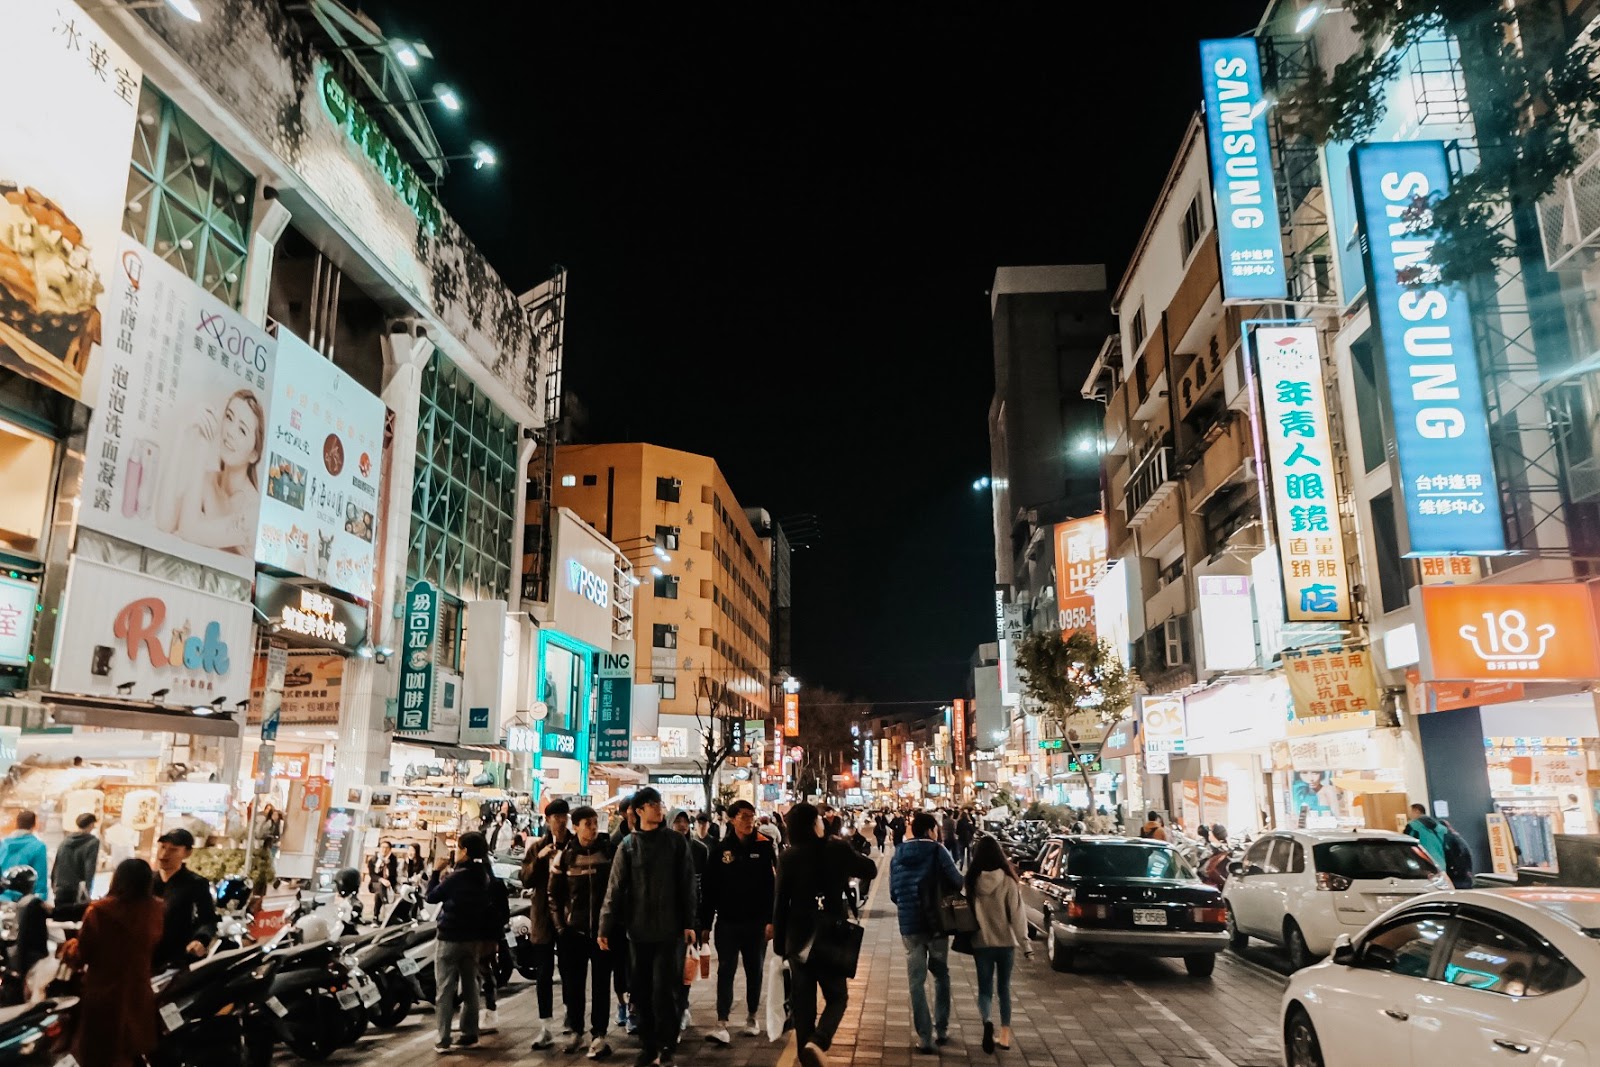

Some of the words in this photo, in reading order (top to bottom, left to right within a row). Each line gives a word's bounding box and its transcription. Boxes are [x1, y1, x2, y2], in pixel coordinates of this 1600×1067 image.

[1214, 57, 1265, 229] SAMSUNG
[1230, 249, 1274, 261] 台中逢甲
[1276, 380, 1330, 532] 年青人眼鏡
[1415, 473, 1482, 491] 台中逢甲
[580, 565, 608, 608] PSGB
[1300, 583, 1338, 612] 店
[114, 597, 229, 675] Rich
[1482, 609, 1529, 653] 18
[604, 654, 630, 669] ING
[1294, 654, 1363, 673] 晴雨兩用
[1313, 670, 1349, 685] 抗UV
[403, 672, 426, 728] 咖啡屋
[1317, 684, 1354, 699] 抗風
[1309, 697, 1367, 714] 特價中
[1146, 706, 1183, 728] OK
[556, 734, 575, 753] PSGB
